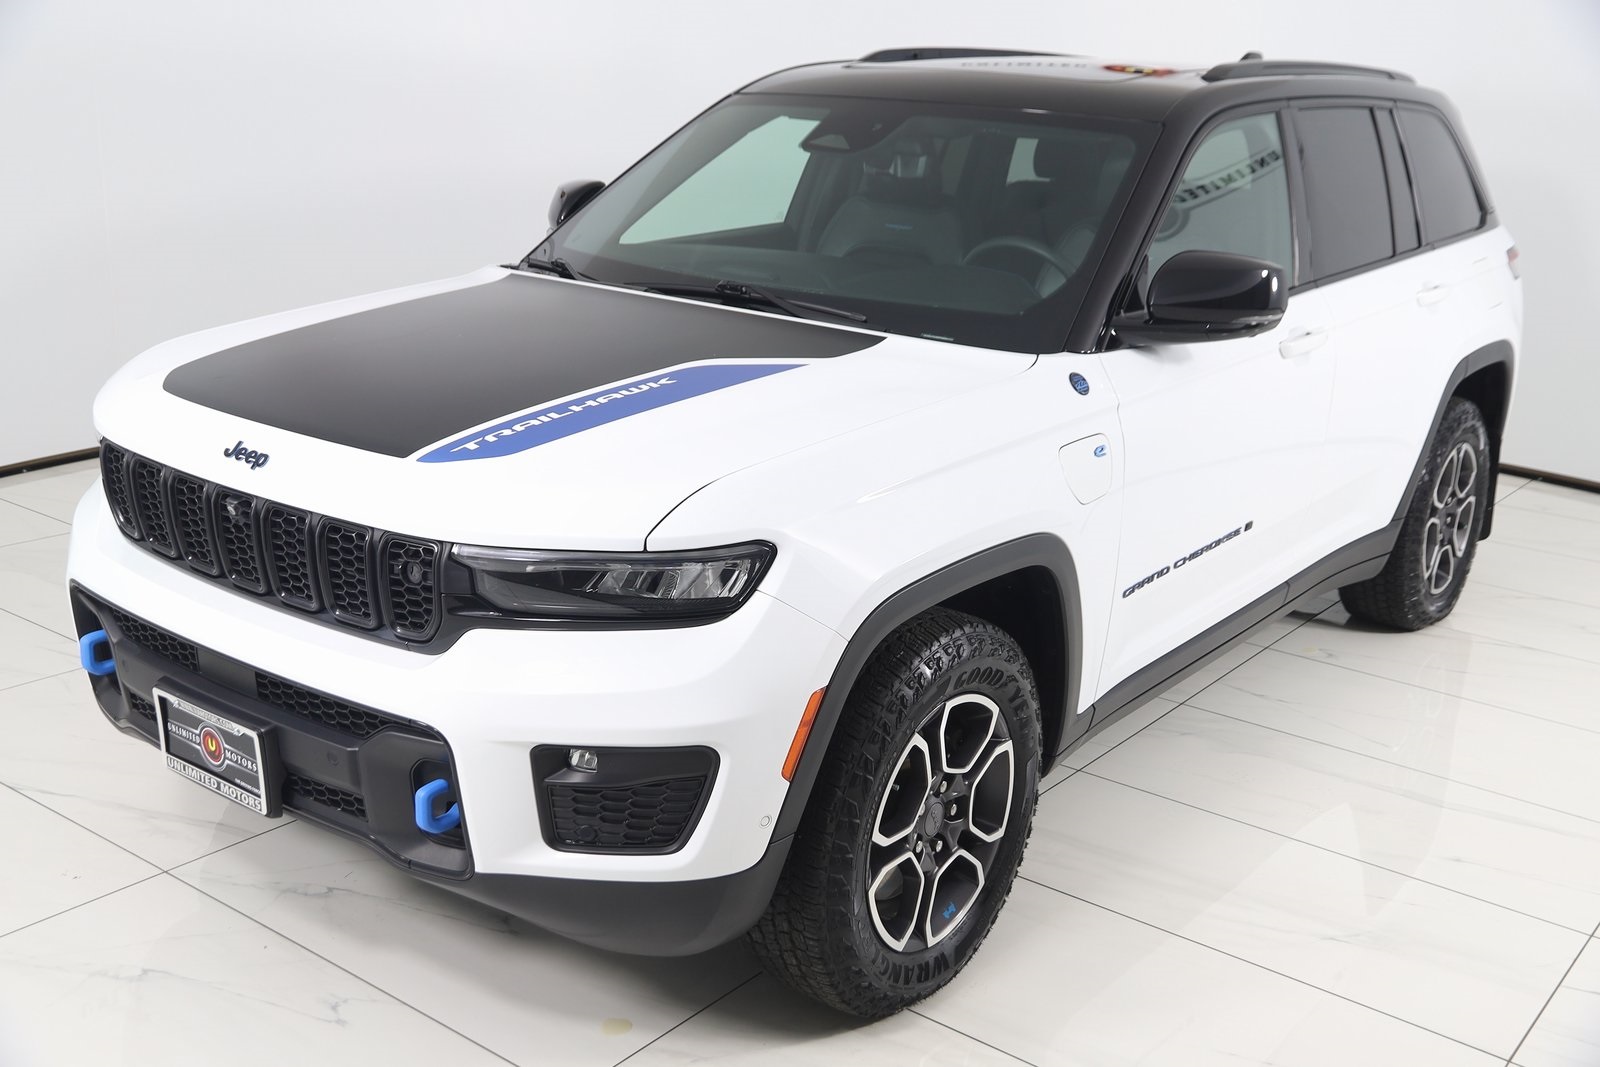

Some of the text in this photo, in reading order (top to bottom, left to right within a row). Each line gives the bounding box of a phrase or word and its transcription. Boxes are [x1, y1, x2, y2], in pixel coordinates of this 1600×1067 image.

[450, 376, 677, 453] TRAILHAWK
[223, 440, 270, 470] Jeep
[1122, 526, 1242, 599] GRAND CHEROKEE
[167, 722, 200, 744] UNLIMITED
[225, 749, 258, 773] MOTORS
[167, 755, 218, 789] UNLIMITED
[220, 783, 261, 810] MOTORS
